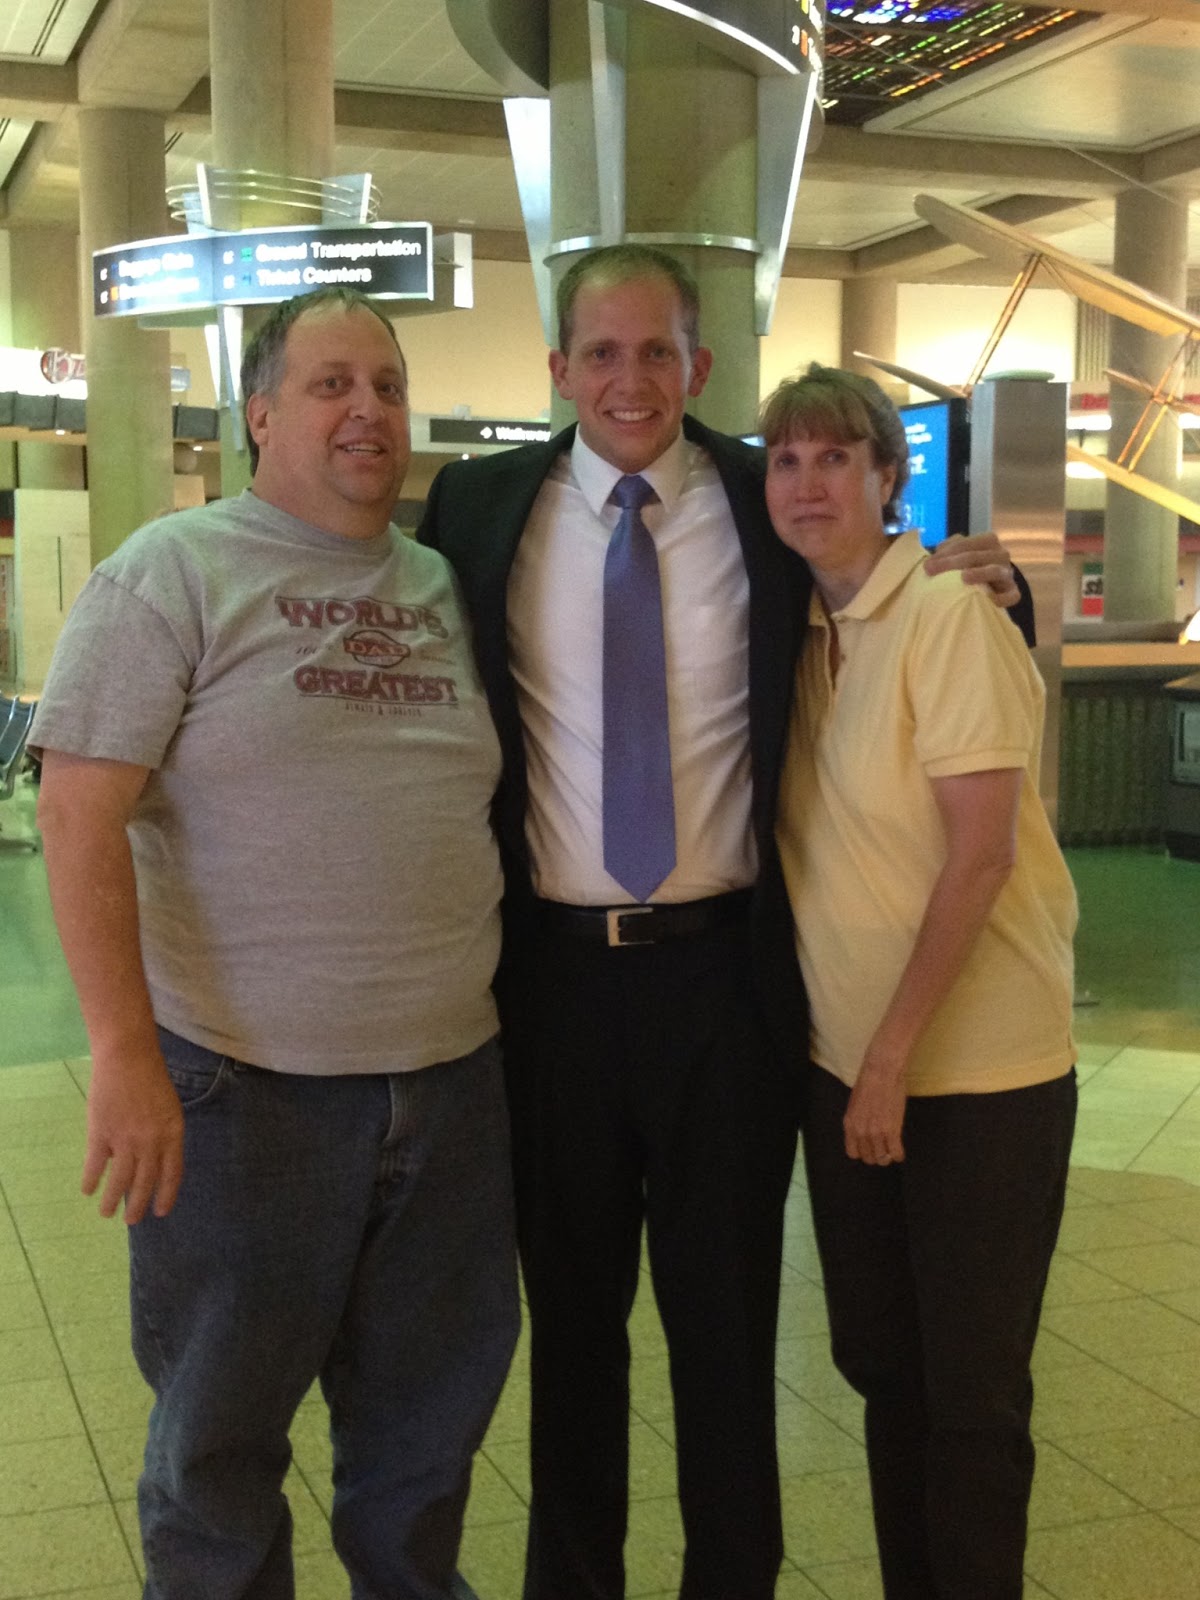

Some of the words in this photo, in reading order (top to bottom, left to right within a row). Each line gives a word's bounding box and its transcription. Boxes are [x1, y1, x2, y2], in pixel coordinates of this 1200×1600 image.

[256, 243, 308, 263] Ground
[311, 239, 422, 261] Transportation
[302, 266, 373, 284] Counters
[275, 598, 449, 639] WORLD'S
[293, 665, 458, 702] GREATEST
